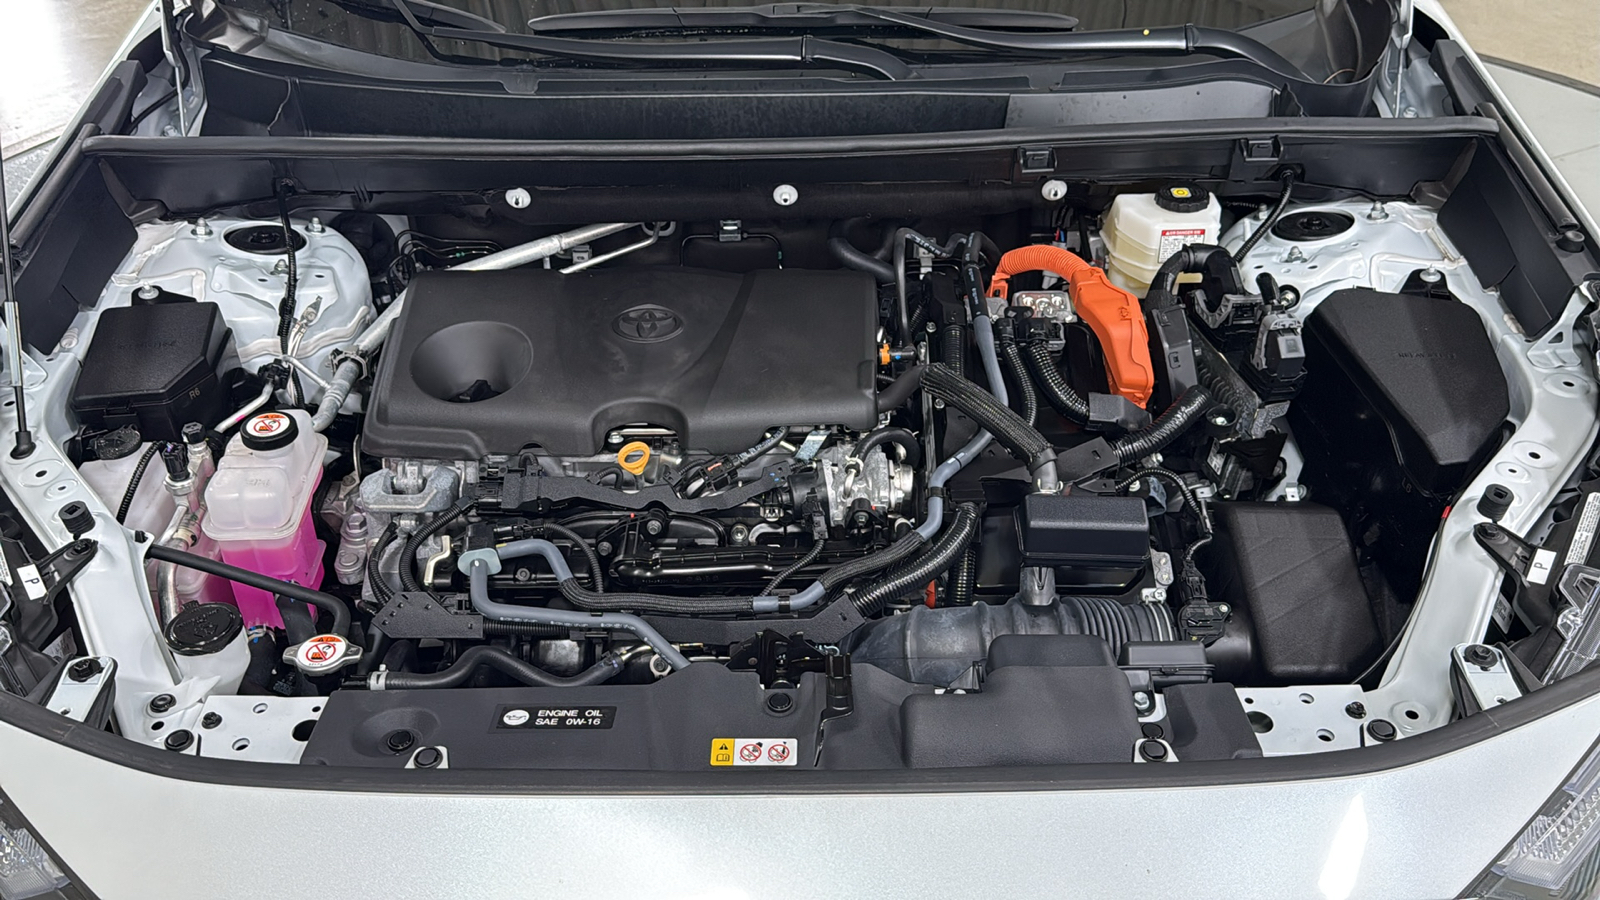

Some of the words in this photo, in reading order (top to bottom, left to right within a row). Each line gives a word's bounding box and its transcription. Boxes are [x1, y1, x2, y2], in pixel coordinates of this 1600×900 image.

[188, 387, 201, 400] R6
[24, 577, 40, 585] P
[537, 709, 579, 717] ENGINE
[585, 709, 603, 717] OIL
[535, 718, 559, 726] SAE
[565, 718, 601, 726] 0W-16
